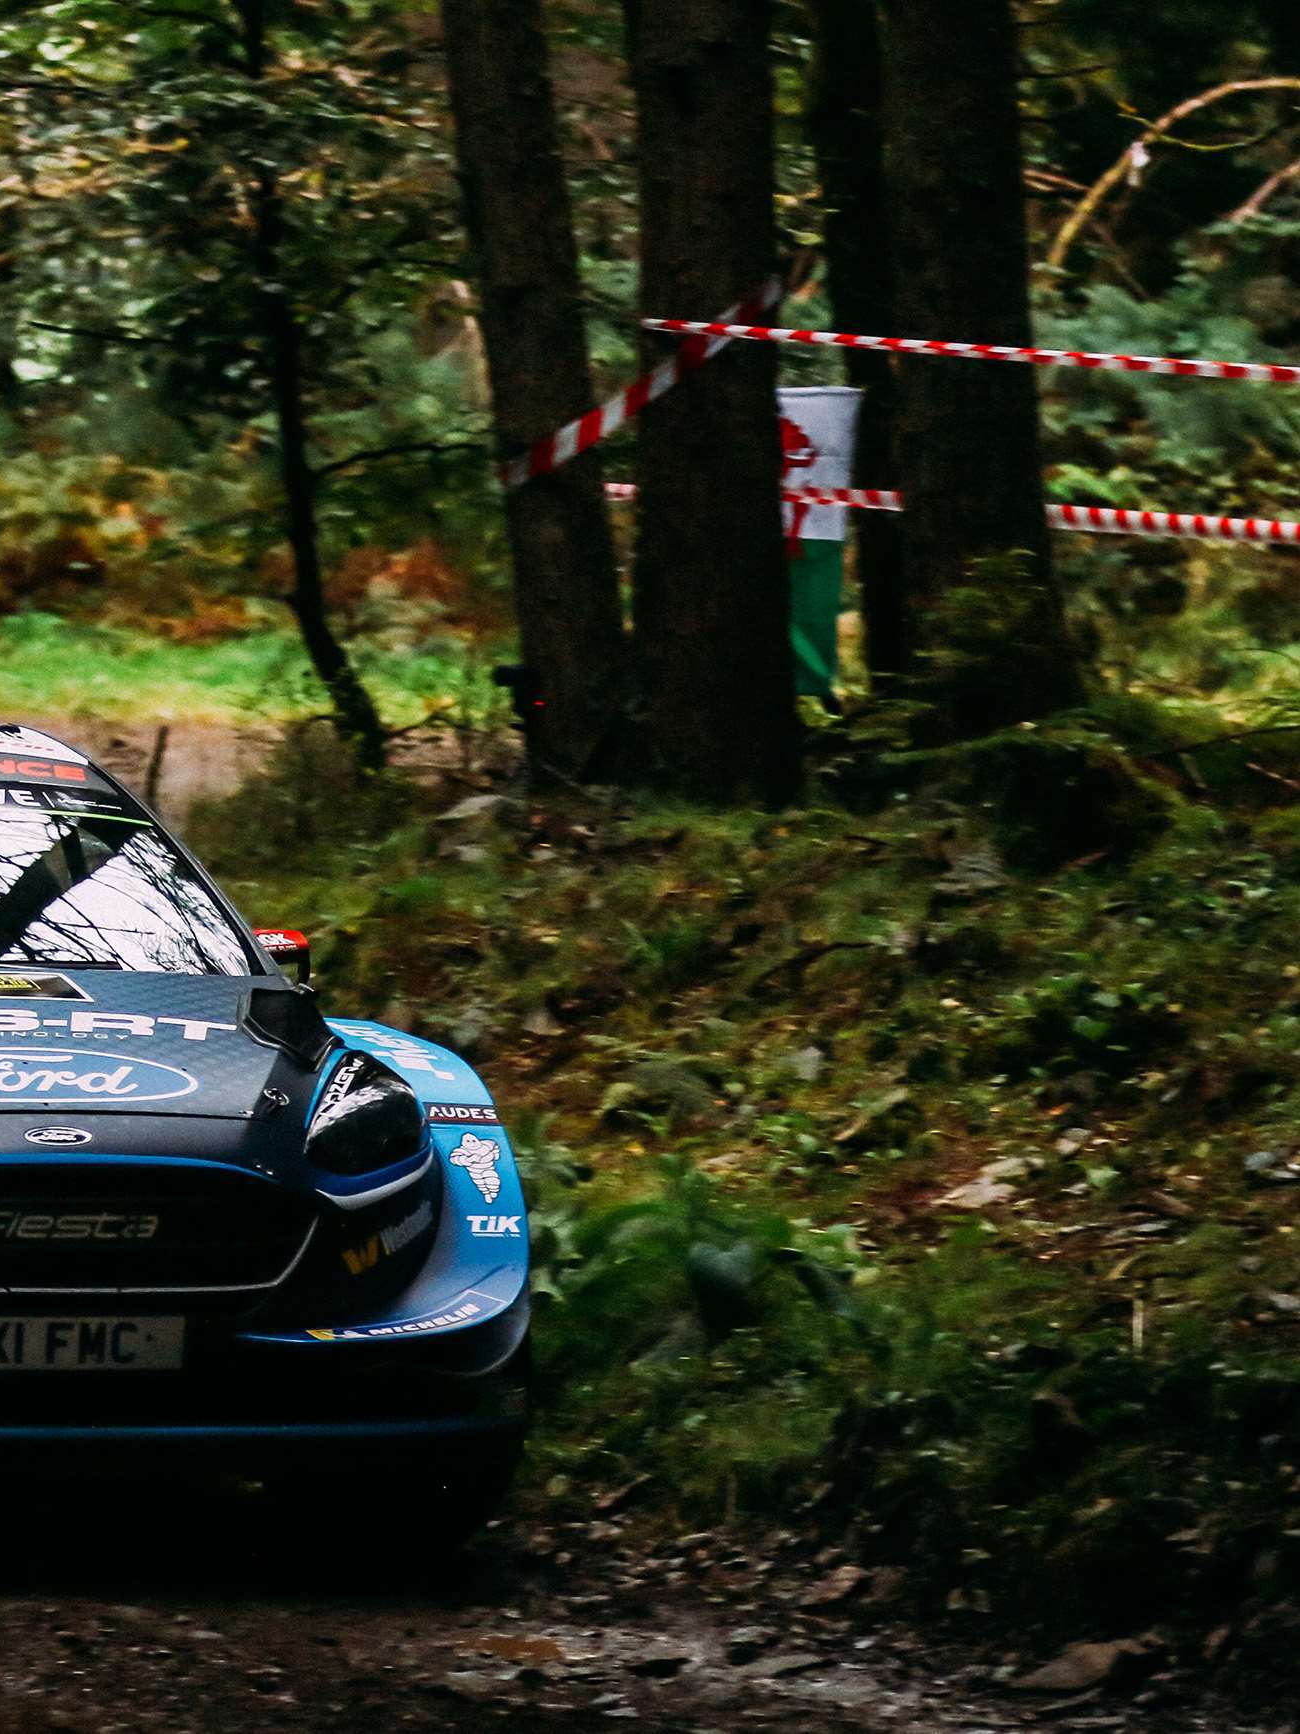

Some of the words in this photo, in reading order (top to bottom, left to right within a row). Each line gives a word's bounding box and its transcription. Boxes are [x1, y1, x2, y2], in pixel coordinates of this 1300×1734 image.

[428, 1104, 498, 1120] AUDES
[368, 1302, 481, 1337] MICHELIN
[45, 1321, 138, 1364] FMC
